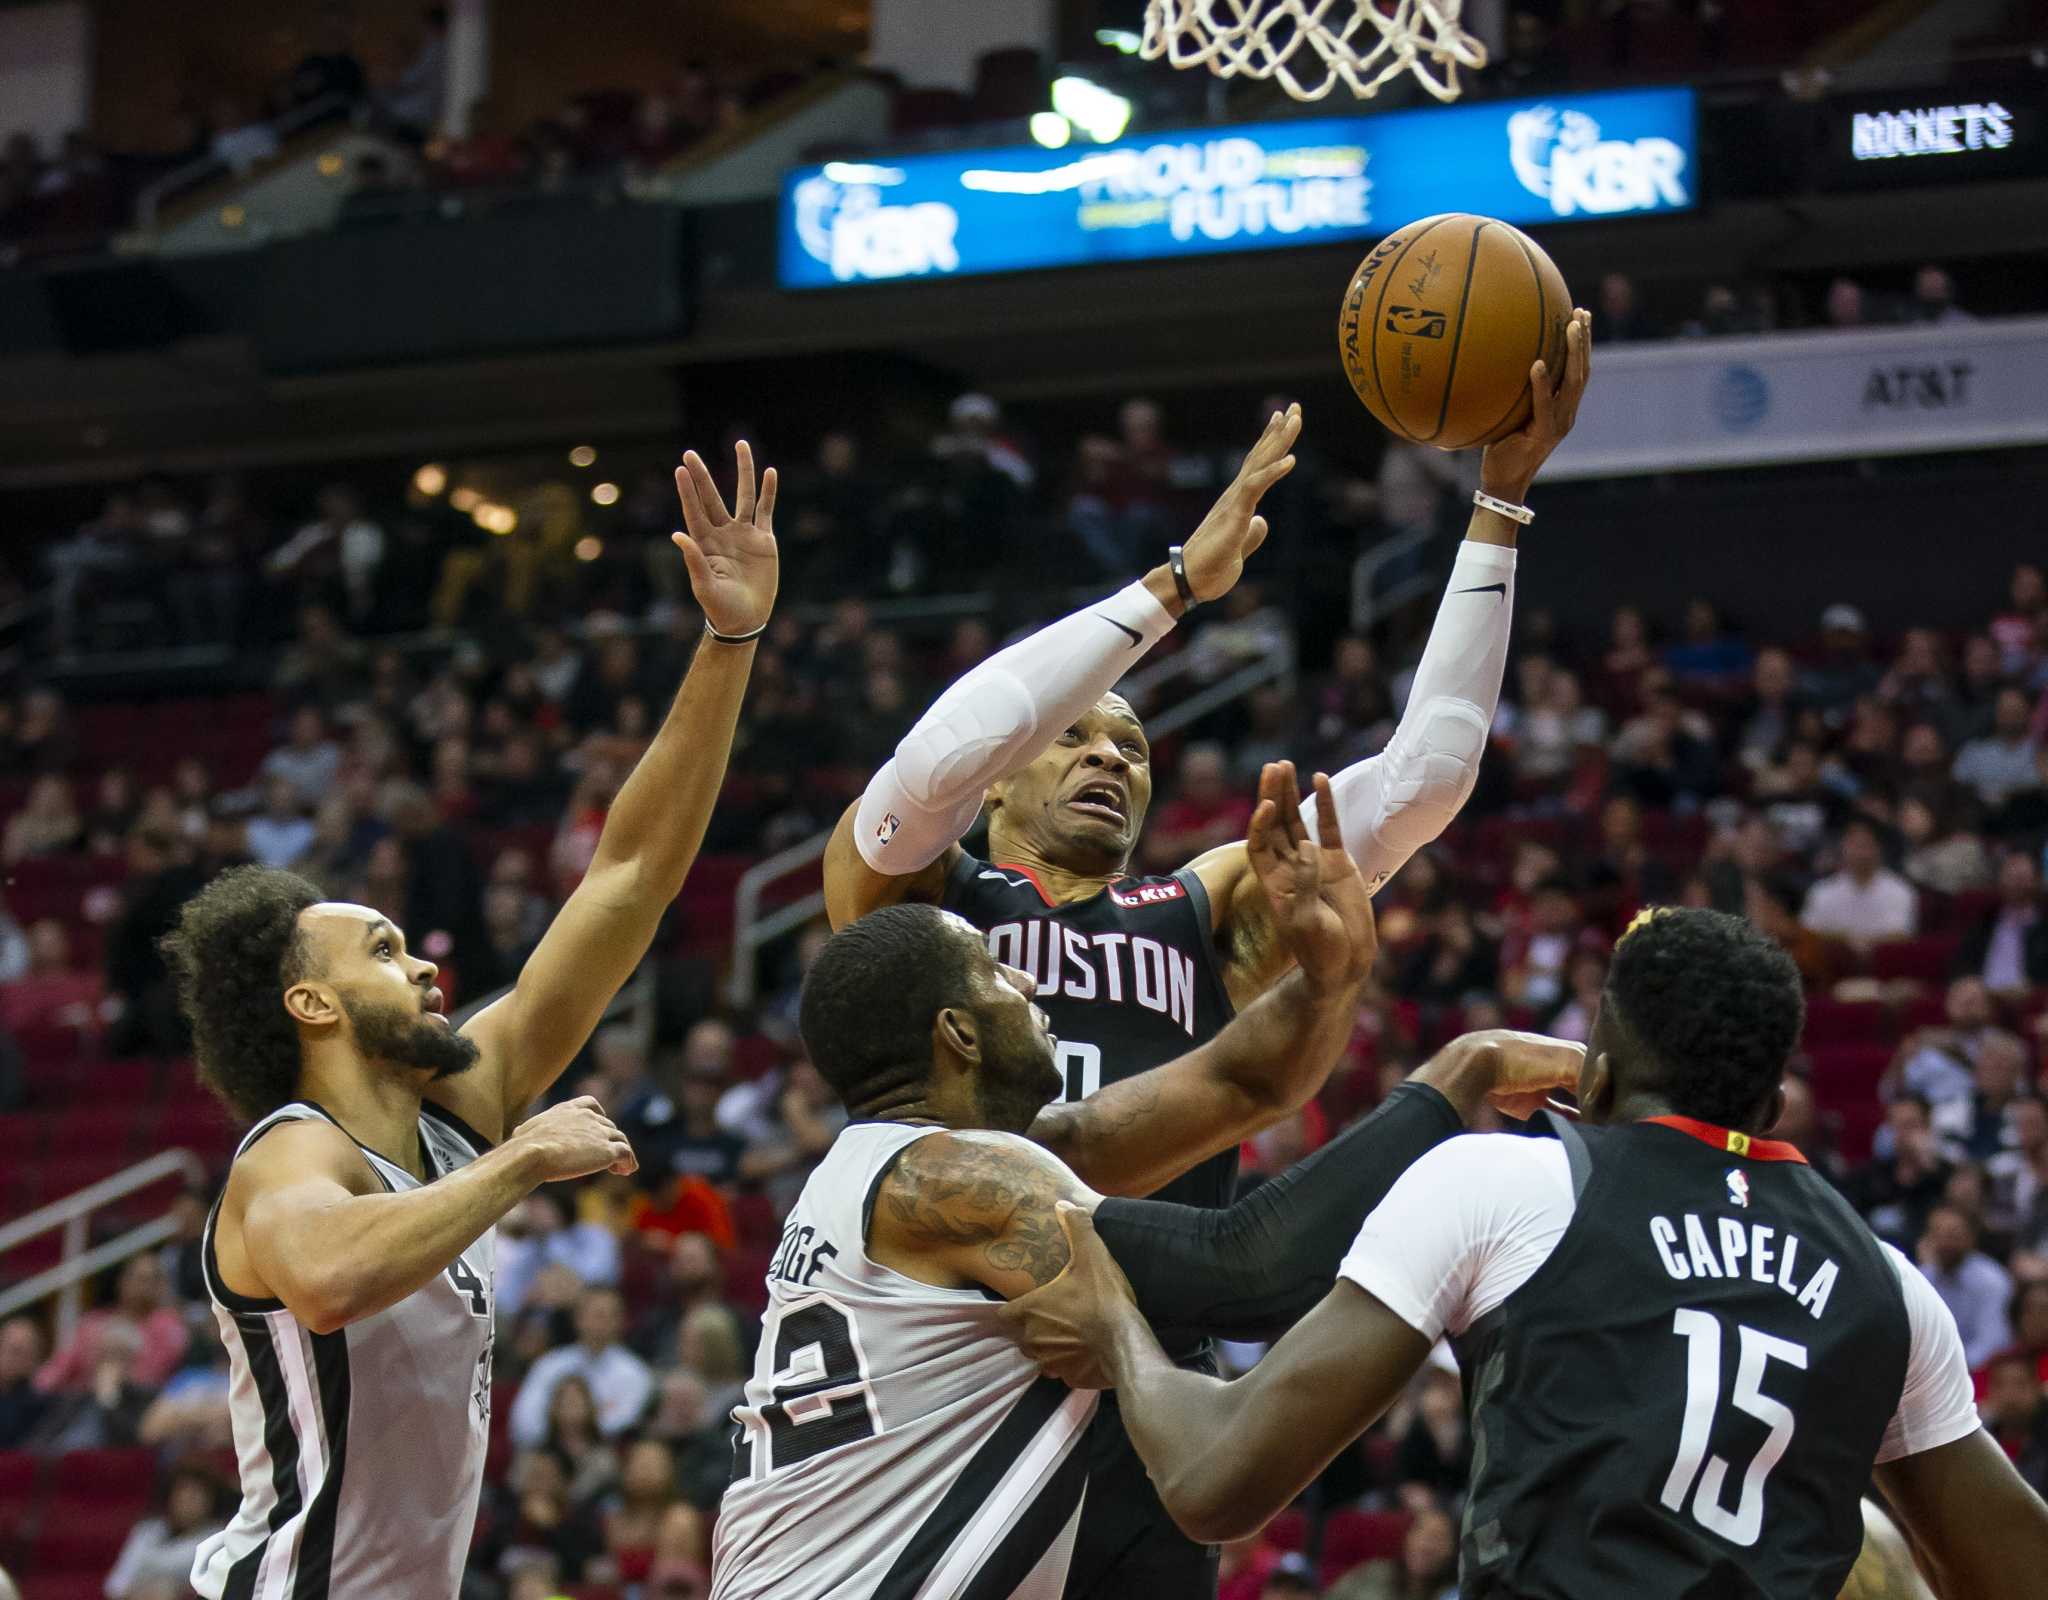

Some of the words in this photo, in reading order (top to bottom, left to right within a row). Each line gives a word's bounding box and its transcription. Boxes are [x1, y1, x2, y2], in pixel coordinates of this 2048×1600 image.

[1170, 176, 1371, 241] FUTURE
[1550, 138, 1688, 214] KBR
[1863, 360, 1972, 413] AT&T
[988, 920, 1194, 1037] OUSTON
[447, 1254, 489, 1318] 4
[1650, 1214, 1840, 1319] CAPELA
[1660, 1307, 1809, 1547] 15
